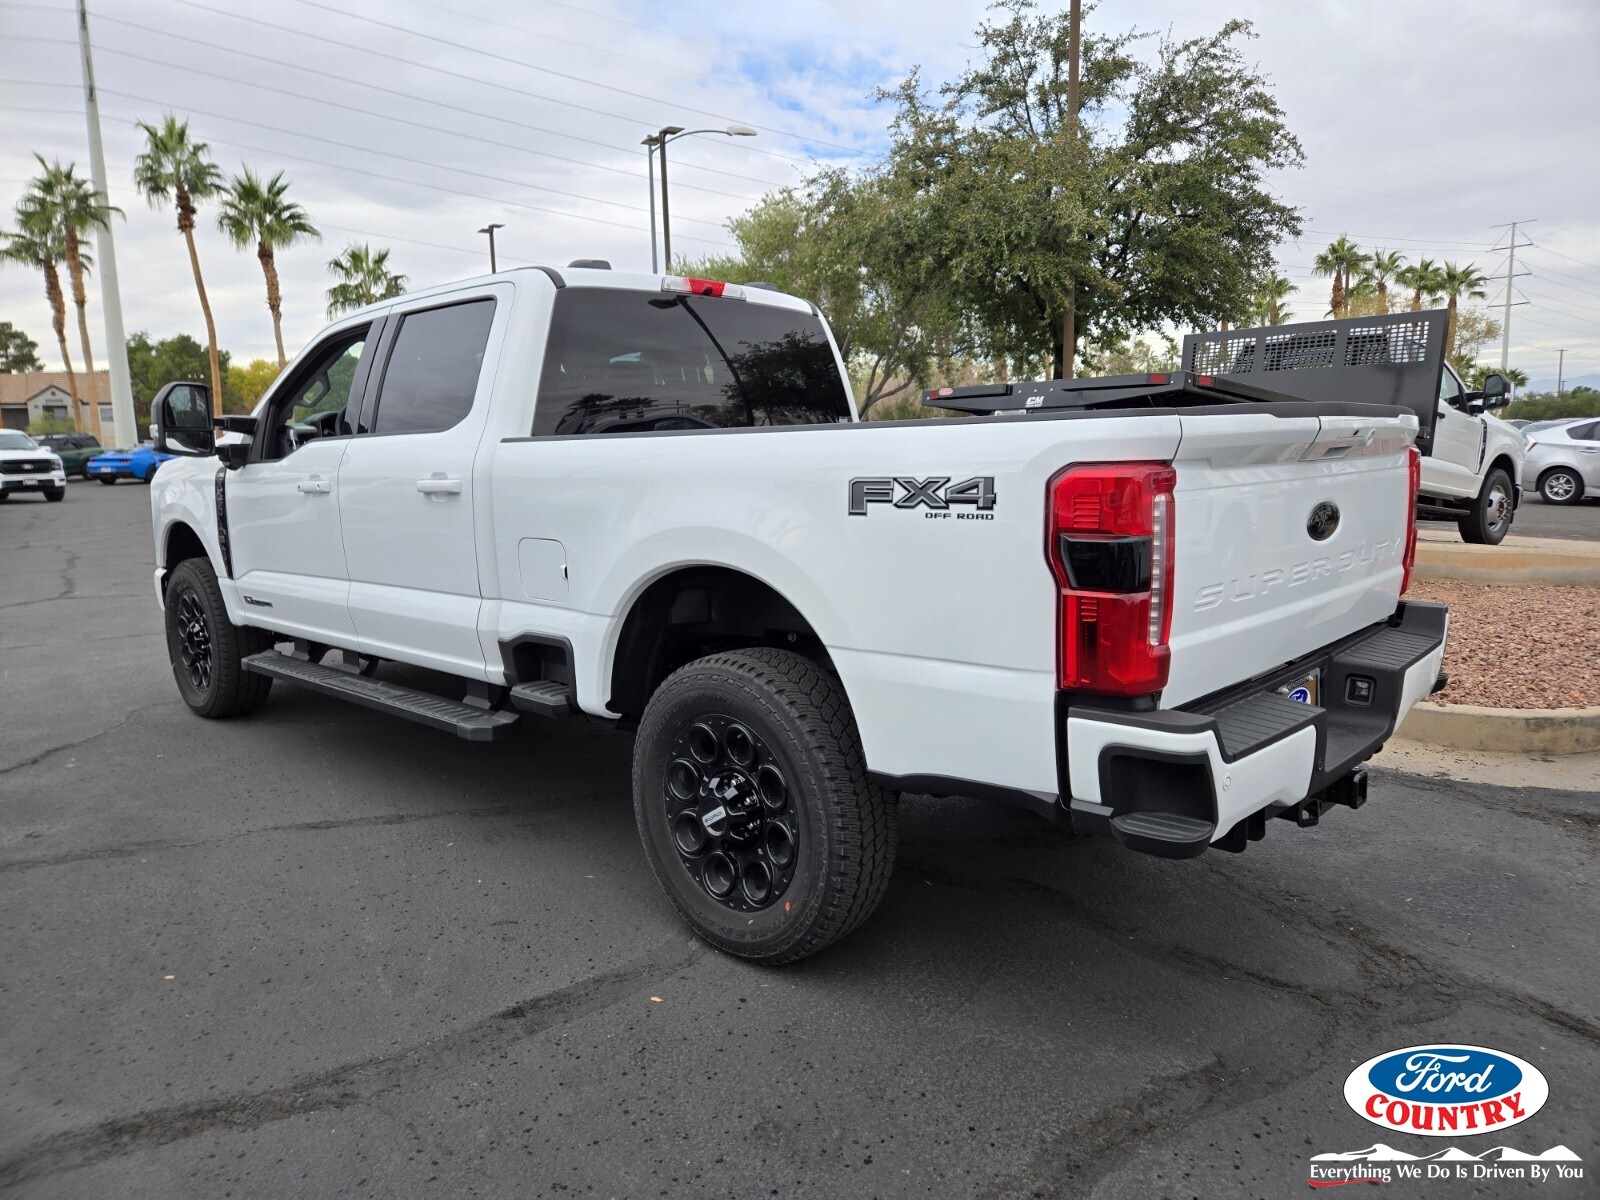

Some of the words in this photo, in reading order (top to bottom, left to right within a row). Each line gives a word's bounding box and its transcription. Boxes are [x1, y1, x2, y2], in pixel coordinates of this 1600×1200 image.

[848, 476, 997, 516] FX4
[925, 512, 952, 520] OFF
[956, 512, 995, 521] ROAD
[1193, 556, 1331, 613] SUPER
[1338, 535, 1401, 573] DUTY
